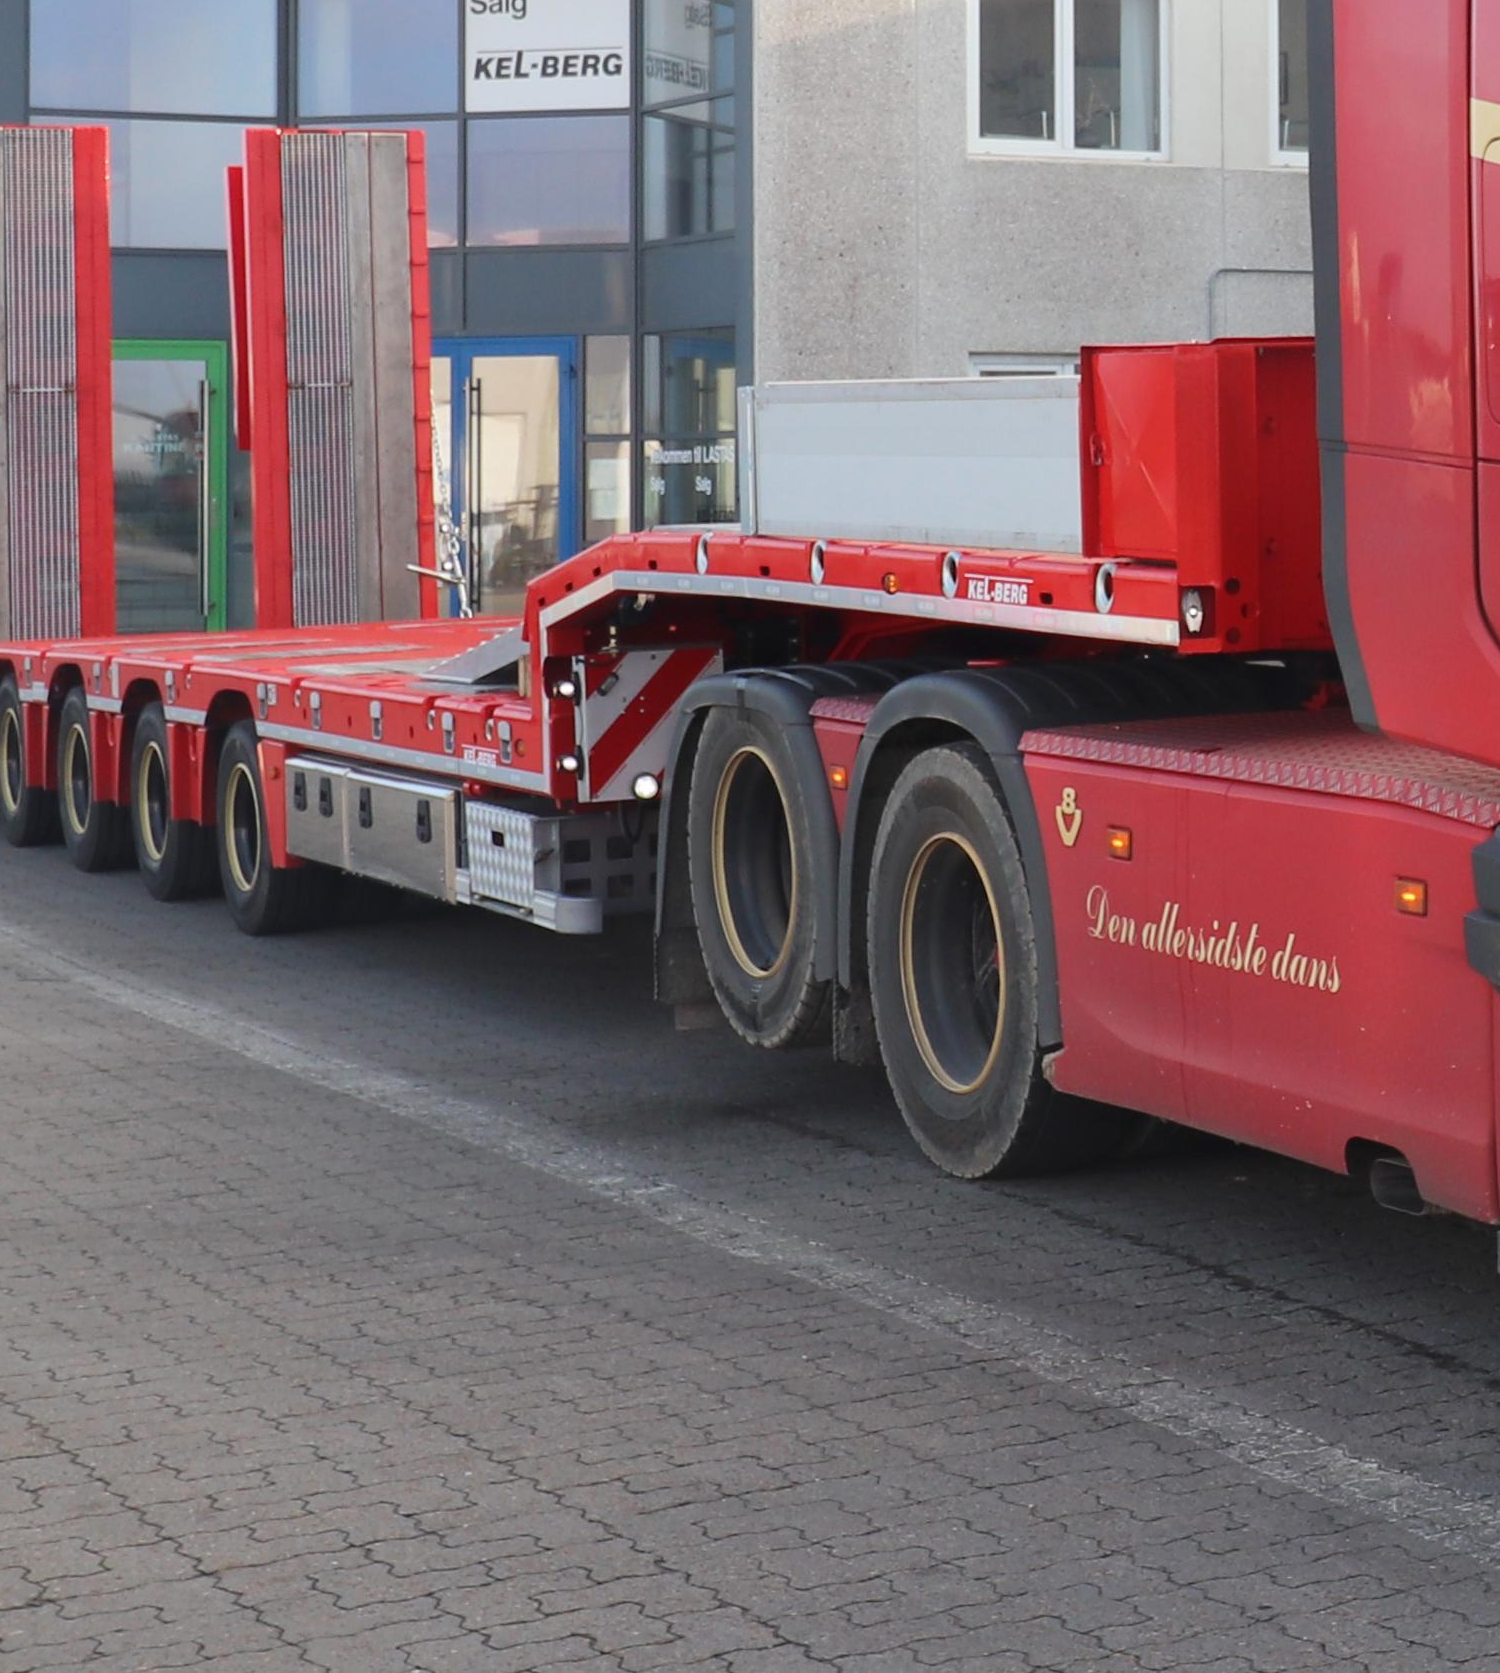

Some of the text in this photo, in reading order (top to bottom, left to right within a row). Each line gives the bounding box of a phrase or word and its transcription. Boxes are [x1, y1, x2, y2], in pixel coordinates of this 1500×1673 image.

[1086, 885, 1341, 994] Den allersidste dans
